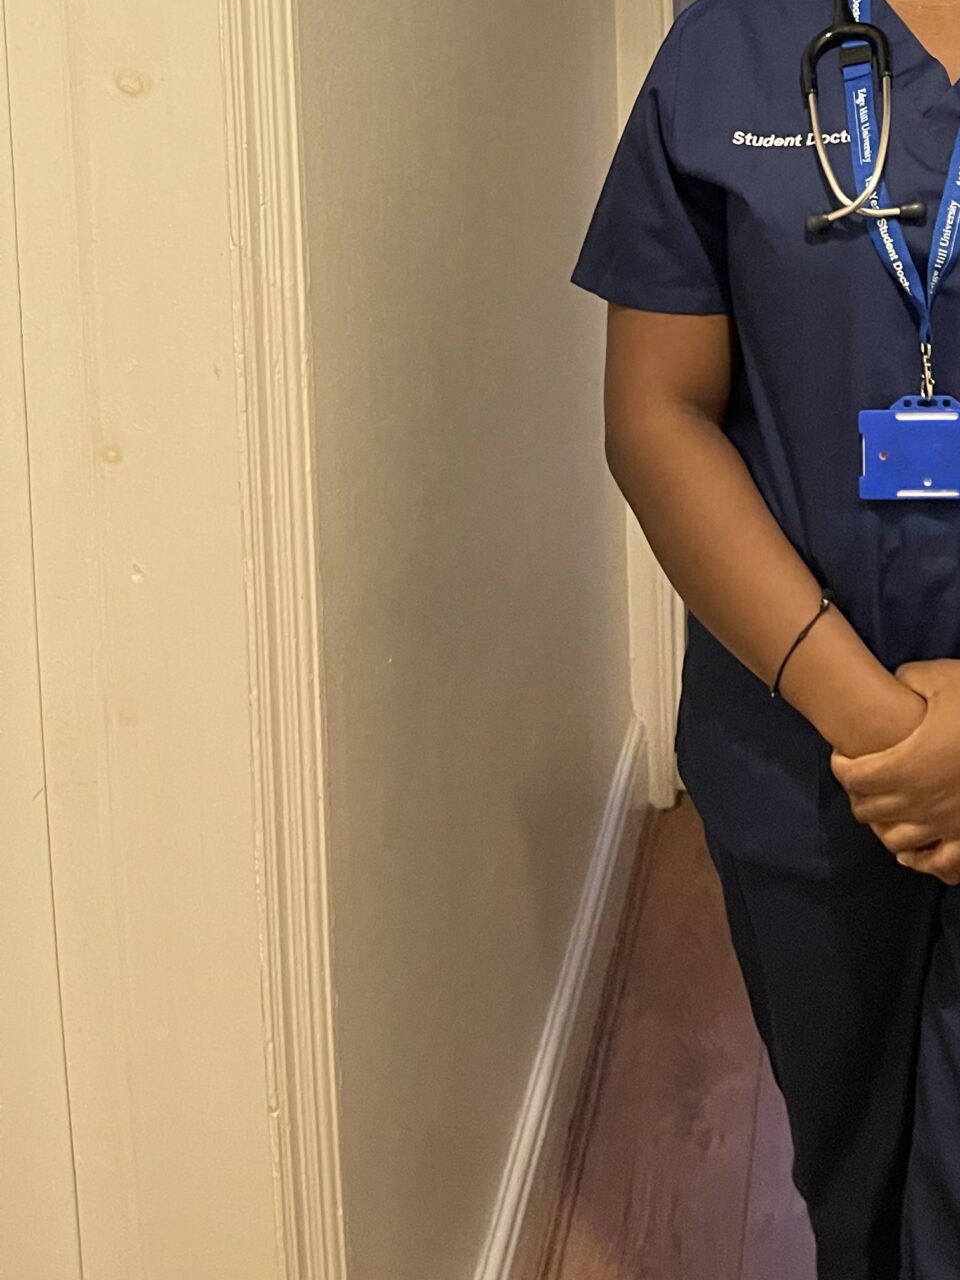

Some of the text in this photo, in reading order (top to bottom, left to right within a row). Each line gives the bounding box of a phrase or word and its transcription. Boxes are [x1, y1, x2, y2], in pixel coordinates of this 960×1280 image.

[859, 106, 869, 124] Hill
[732, 131, 803, 147] Student
[861, 122, 872, 163] University
[939, 199, 960, 248] University
[876, 218, 898, 261] Student
[934, 248, 948, 269] Hill
